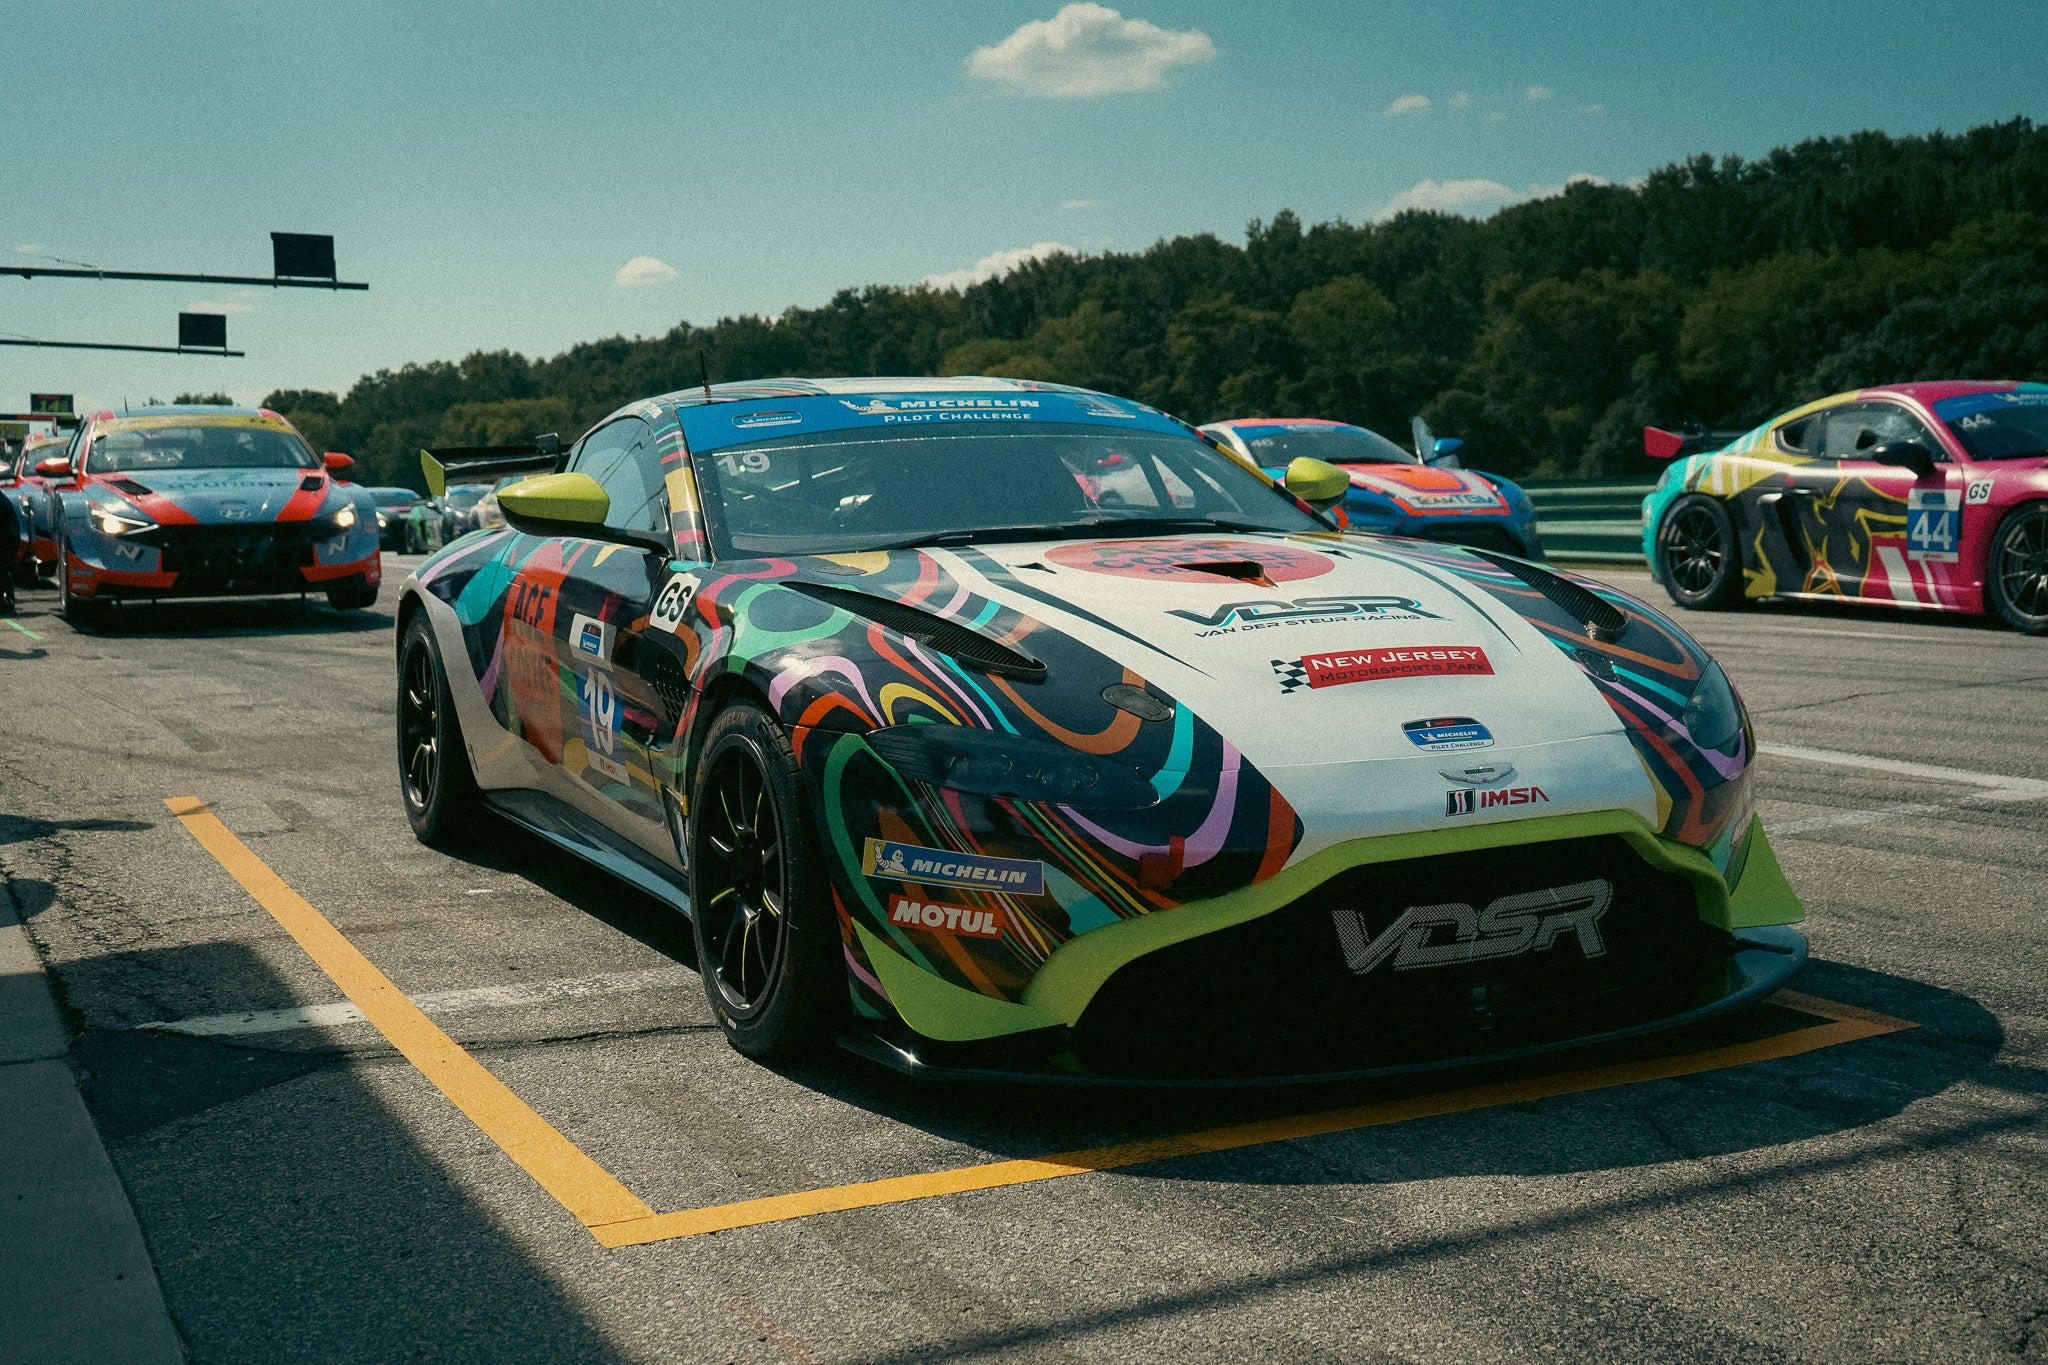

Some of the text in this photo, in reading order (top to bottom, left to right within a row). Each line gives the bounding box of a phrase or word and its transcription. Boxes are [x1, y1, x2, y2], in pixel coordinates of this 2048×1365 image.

[900, 399, 1040, 409] MICHELIN
[884, 412, 1032, 423] PILOT CHALLENGE
[717, 452, 771, 477] 19
[1968, 483, 1990, 499] GS
[1911, 511, 1953, 550] 44
[1092, 550, 1308, 569] COFFEE
[657, 582, 692, 622] GS
[1164, 595, 1450, 627] VDSR
[1195, 613, 1422, 638] VAN DER STEUR RACING
[1311, 650, 1479, 671] NEW JERSEY
[1319, 662, 1488, 683] MOTORSPORTS PARK
[584, 667, 615, 755] 19
[1436, 730, 1478, 738] MICHELIN
[1481, 787, 1550, 808] IMSA
[911, 858, 1028, 884] MICHELIN
[892, 900, 998, 935] MOTUL
[1331, 878, 1614, 975] VDSR
